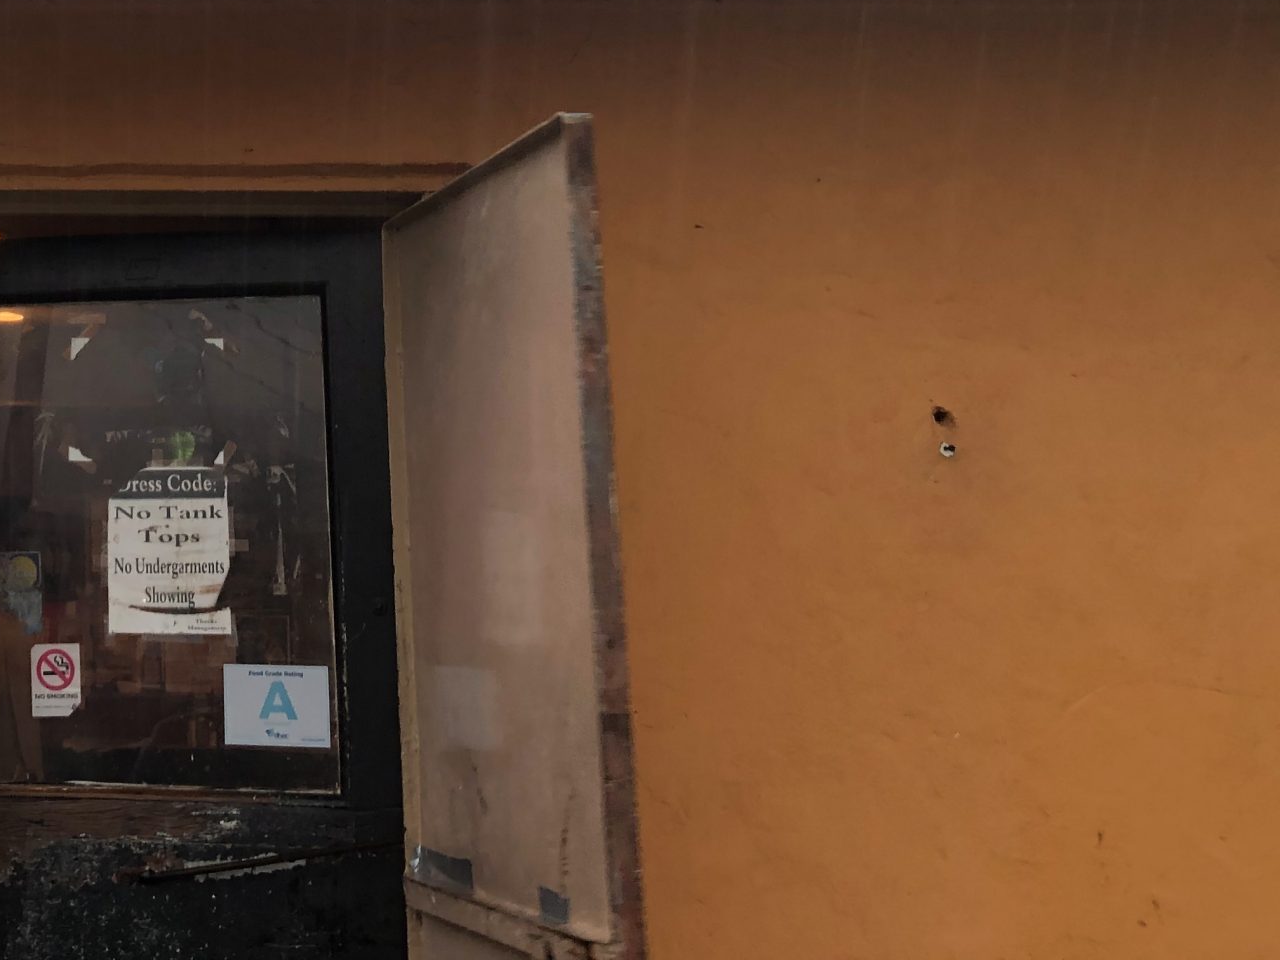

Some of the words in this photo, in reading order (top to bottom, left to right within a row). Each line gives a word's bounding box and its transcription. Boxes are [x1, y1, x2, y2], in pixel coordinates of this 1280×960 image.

[167, 473, 217, 492] Code:
[114, 505, 151, 520] No
[158, 504, 223, 520] Tank
[138, 527, 200, 547] Tops
[114, 557, 132, 575] No
[135, 557, 225, 579] Undergarments
[144, 585, 195, 608] Showing
[259, 680, 298, 720] A
